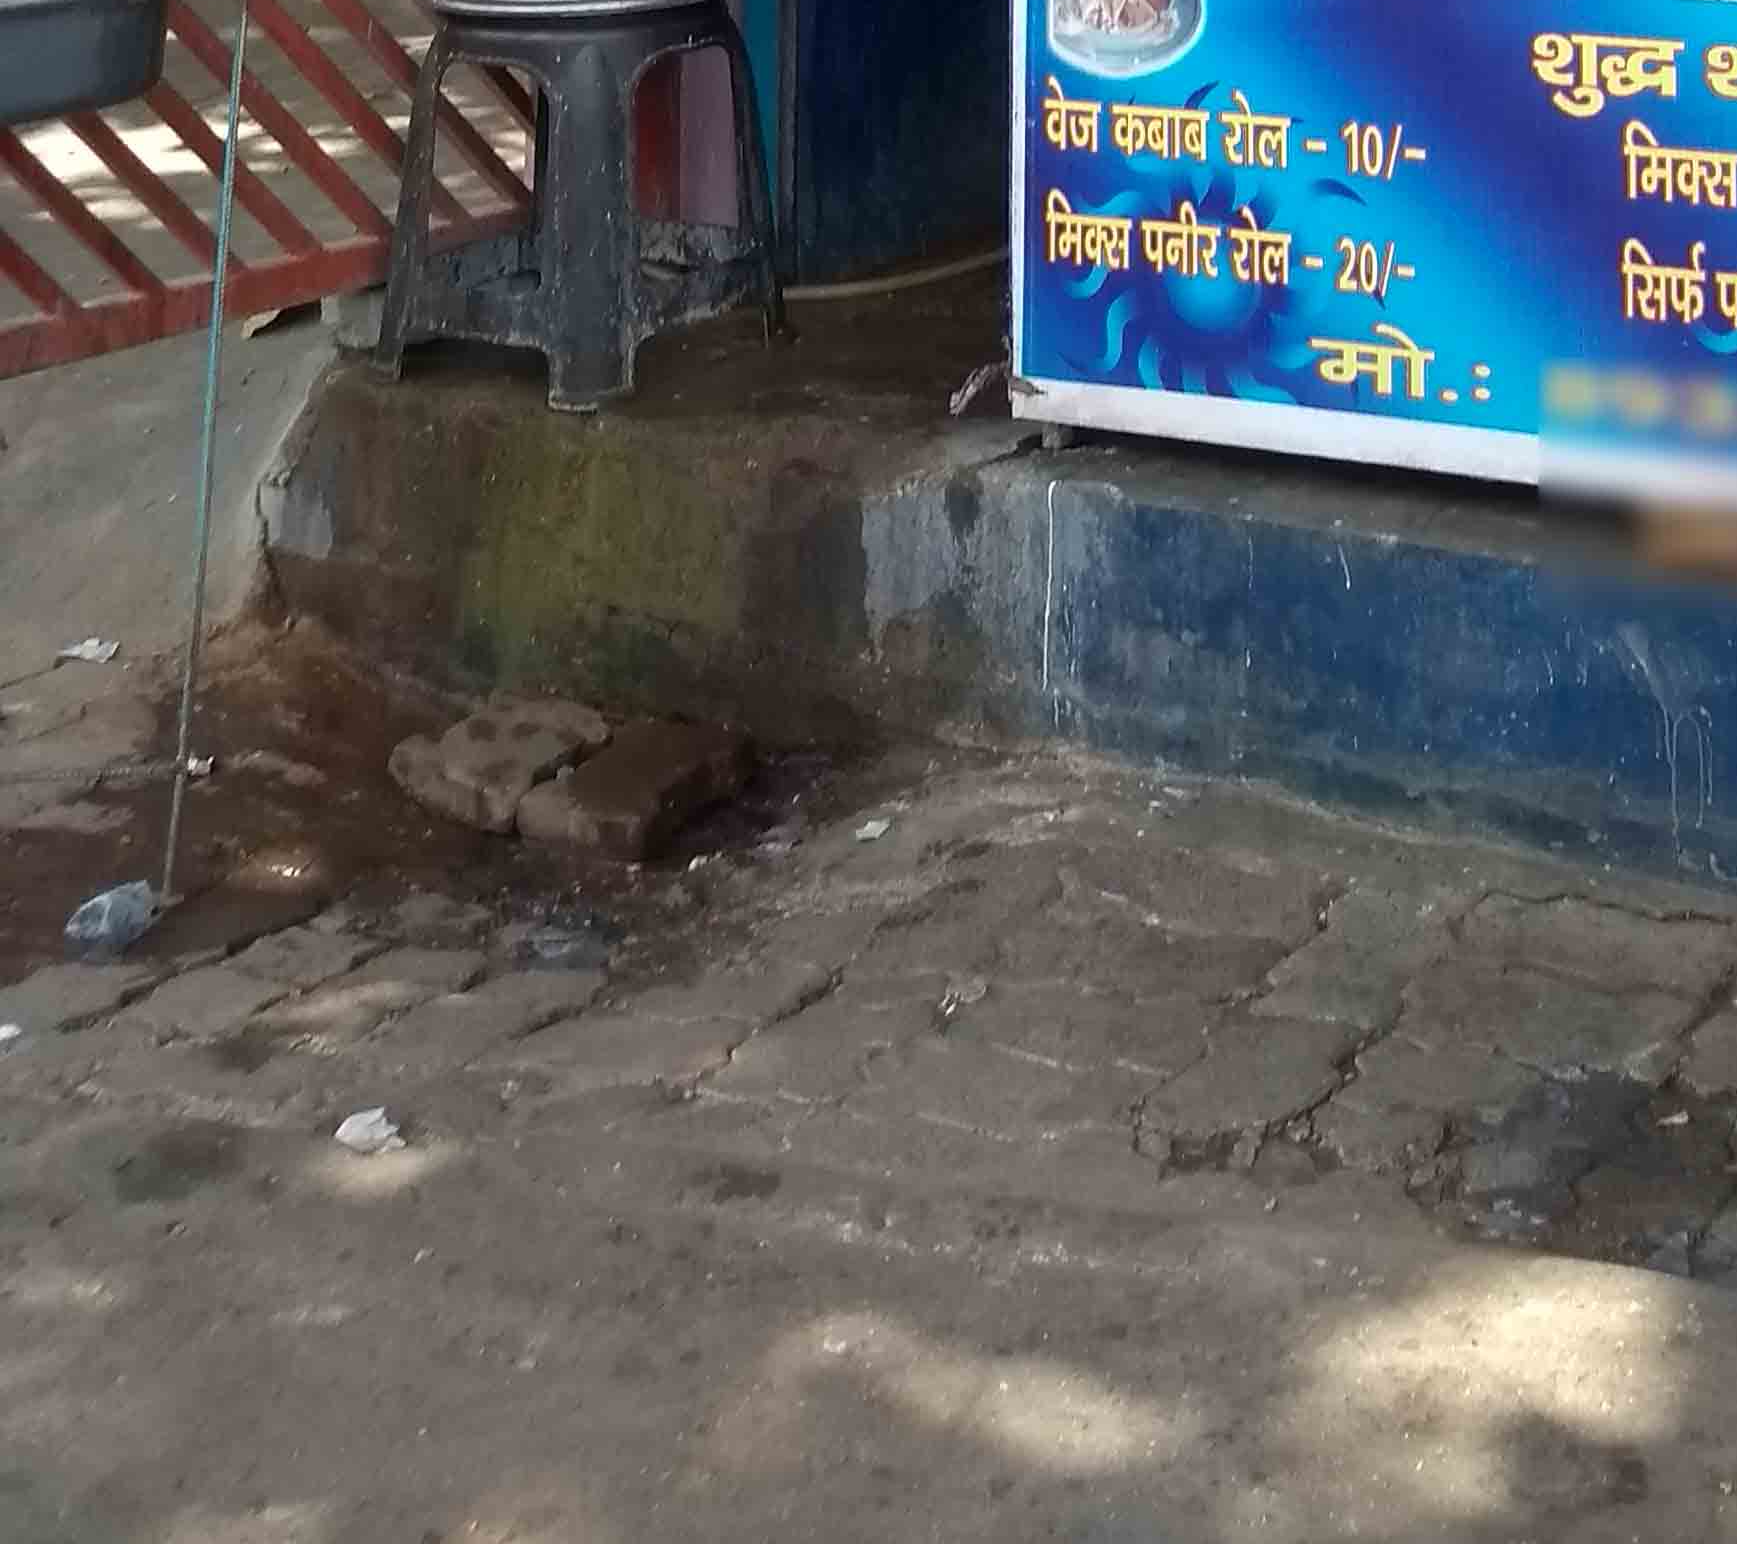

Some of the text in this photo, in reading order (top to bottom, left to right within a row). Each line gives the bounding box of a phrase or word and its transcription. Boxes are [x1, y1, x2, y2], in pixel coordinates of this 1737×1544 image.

[1531, 29, 1686, 119] शुद्ध
[1042, 75, 1101, 154] वेज
[1111, 100, 1210, 165] कबाब
[1219, 88, 1292, 170] रोल
[1342, 120, 1428, 180] 10/-
[1044, 188, 1132, 272] मिक्स
[1140, 200, 1222, 280] पनीर
[1229, 206, 1292, 286] रोल
[1334, 237, 1417, 296] 20/-
[1620, 238, 1707, 325] सिर्फ
